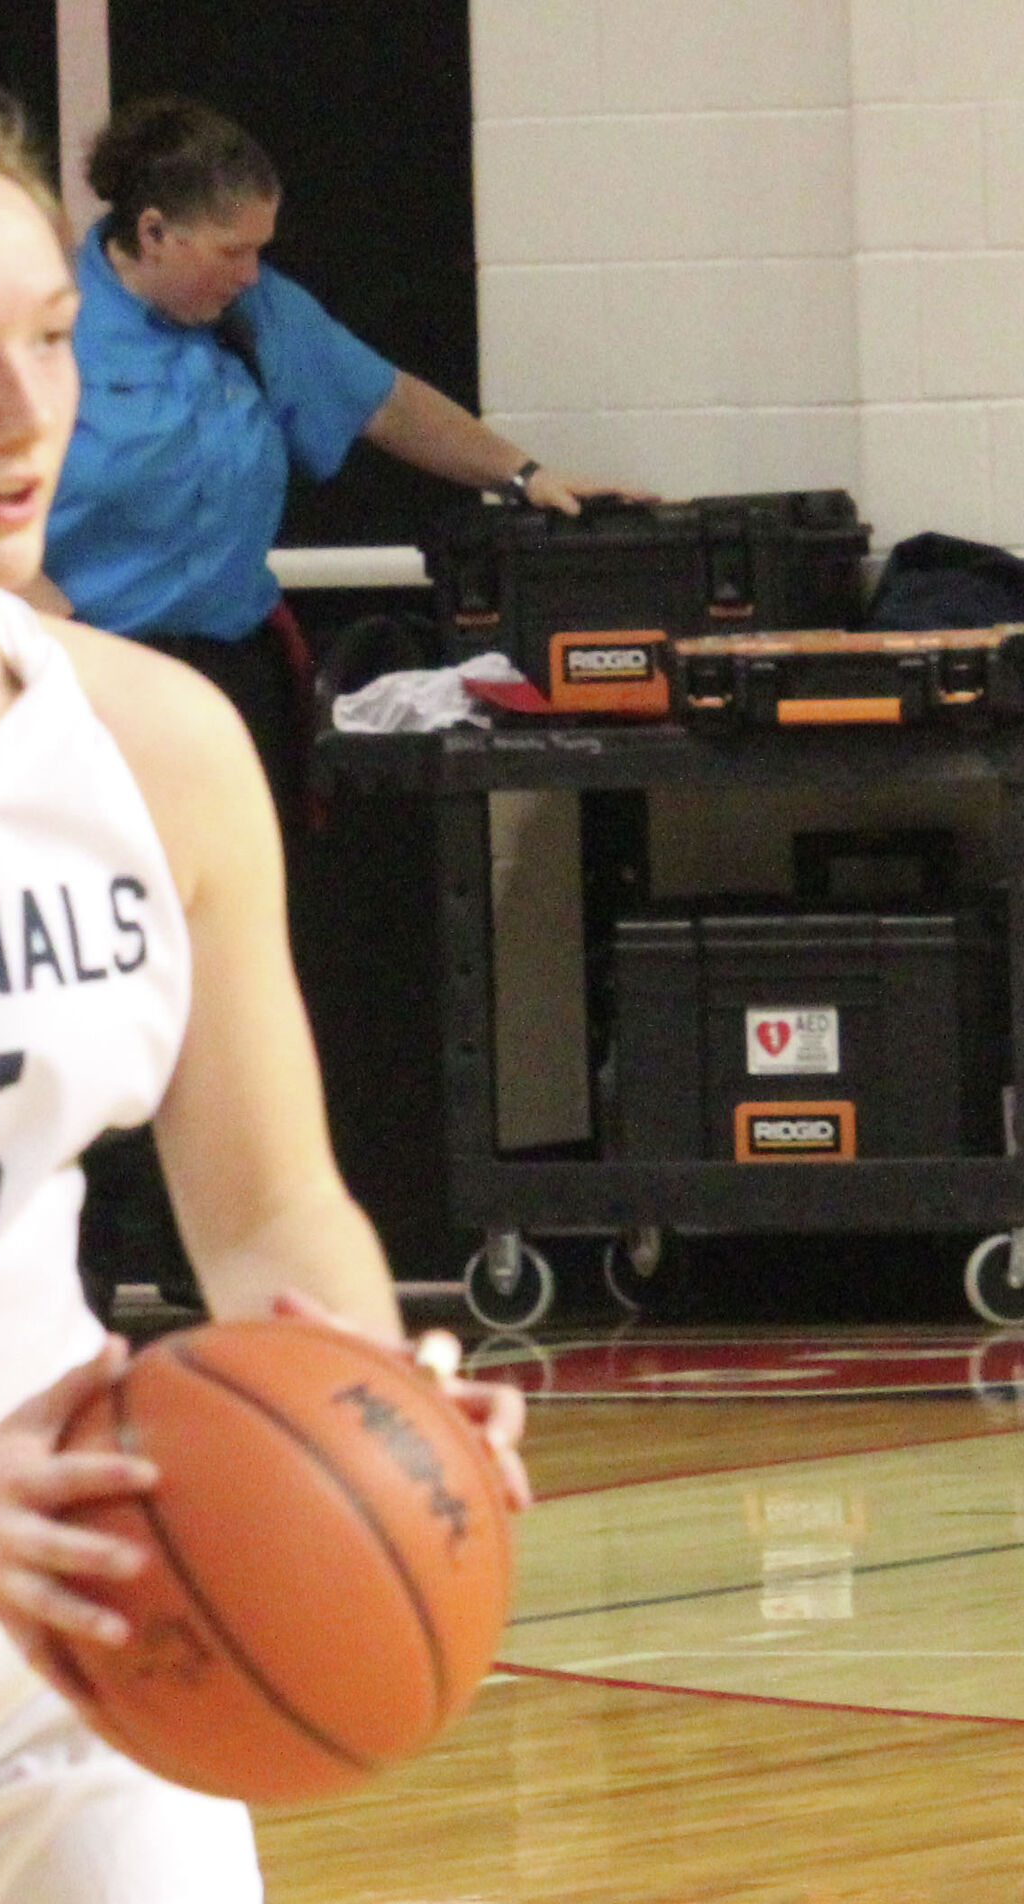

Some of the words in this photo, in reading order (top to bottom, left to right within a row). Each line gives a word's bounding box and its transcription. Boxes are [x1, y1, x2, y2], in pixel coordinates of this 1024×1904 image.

[568, 649, 648, 671] RIDGID
[795, 1013, 831, 1033] AED
[753, 1121, 835, 1142] RIDGID
